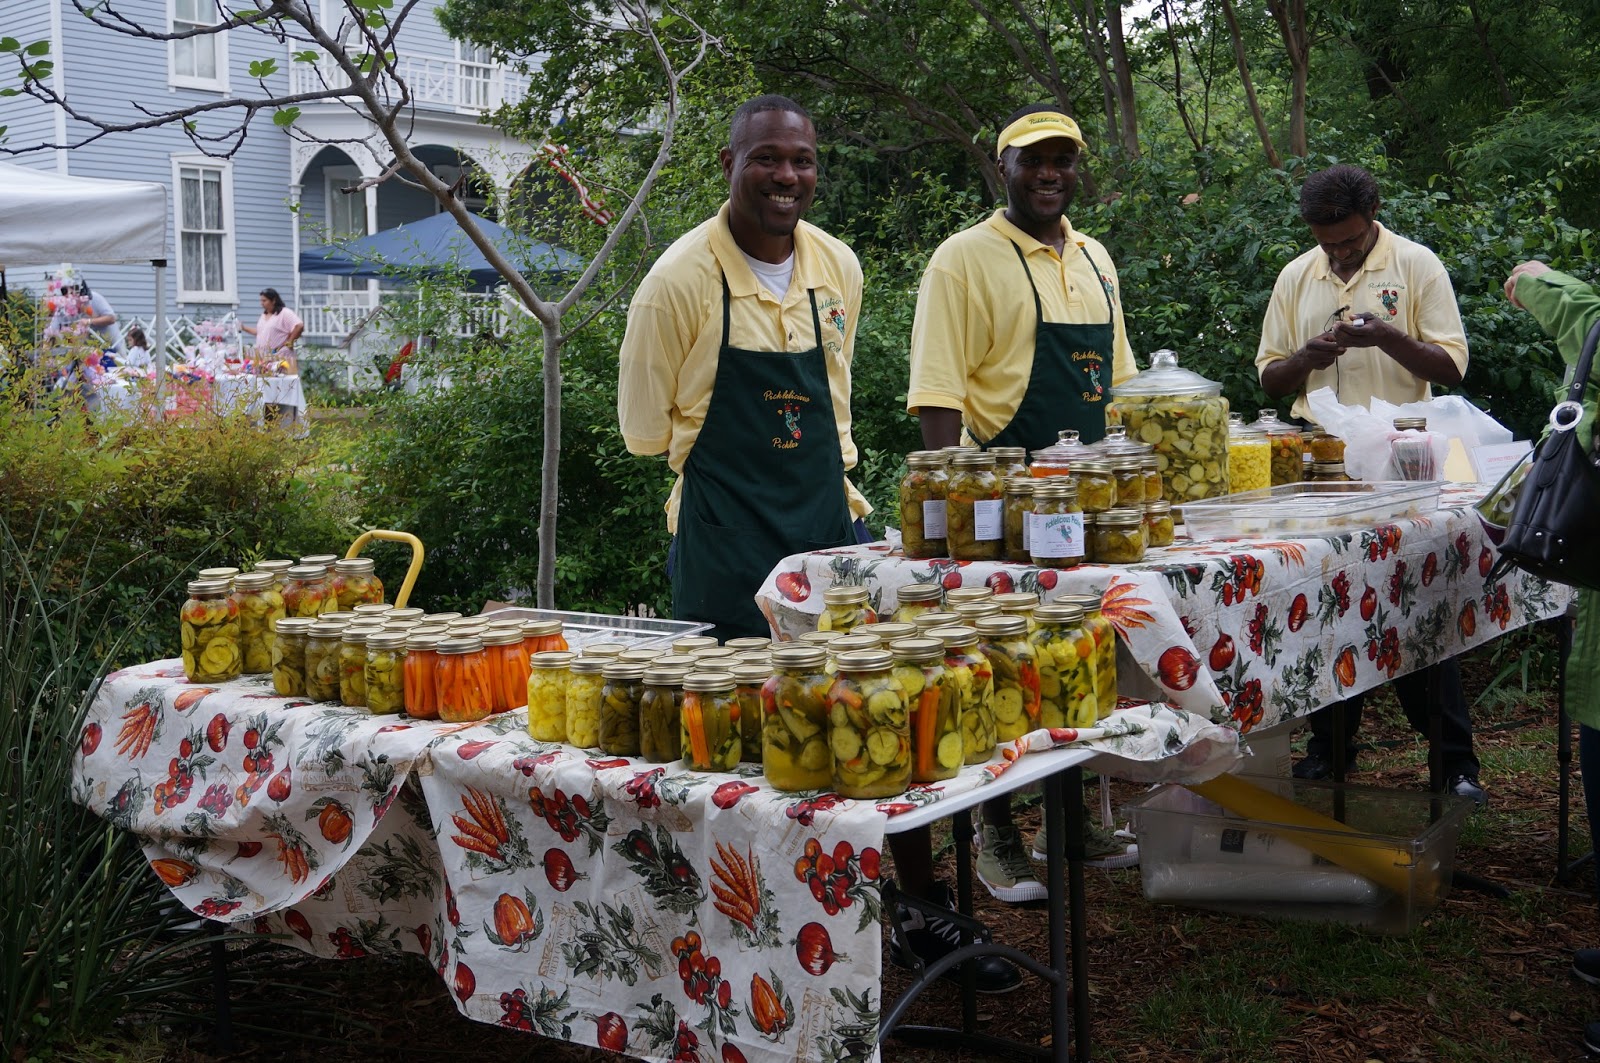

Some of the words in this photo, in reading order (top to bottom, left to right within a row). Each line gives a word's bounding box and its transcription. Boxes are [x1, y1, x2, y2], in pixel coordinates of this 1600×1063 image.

[553, 916, 567, 954] ONIONS
[549, 956, 560, 976] RED
[806, 1005, 823, 1049] ONIONS
